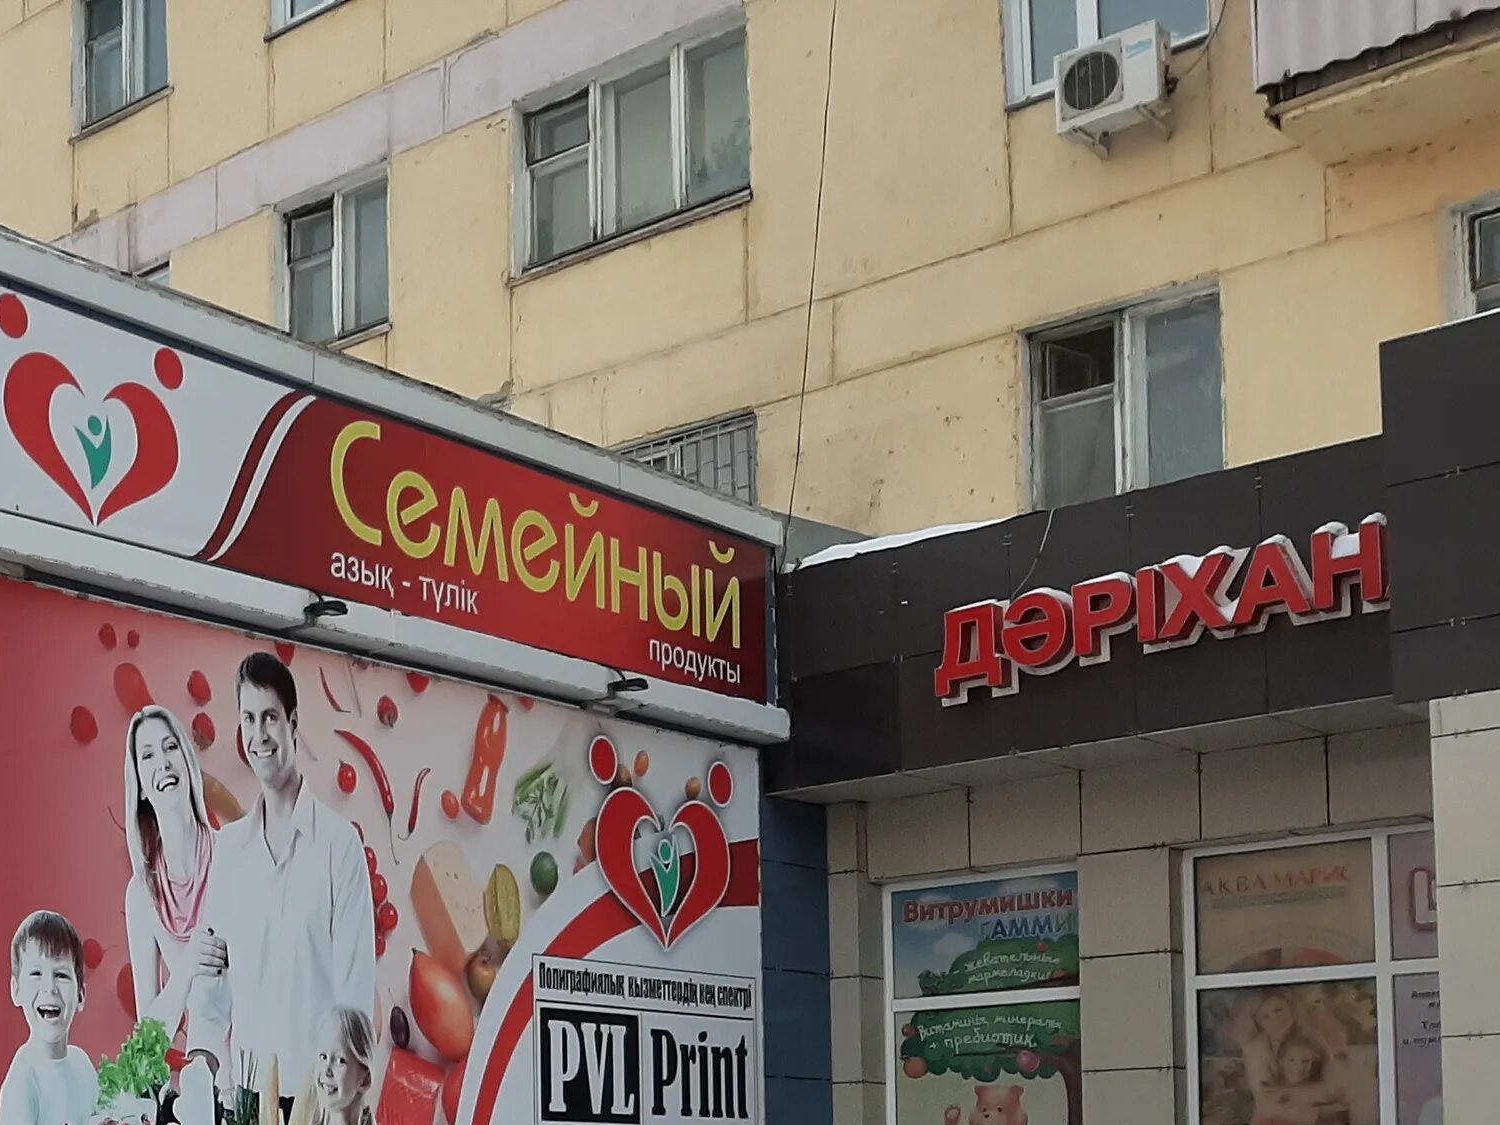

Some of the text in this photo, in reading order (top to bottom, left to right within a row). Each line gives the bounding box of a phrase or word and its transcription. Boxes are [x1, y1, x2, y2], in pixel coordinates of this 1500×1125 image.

[330, 419, 741, 649] Семейный
[330, 552, 395, 599] азық
[418, 574, 478, 615] түлік
[649, 638, 741, 684] продукты
[903, 888, 1073, 925] Витрумишки
[547, 1019, 749, 1119] PVL Print
